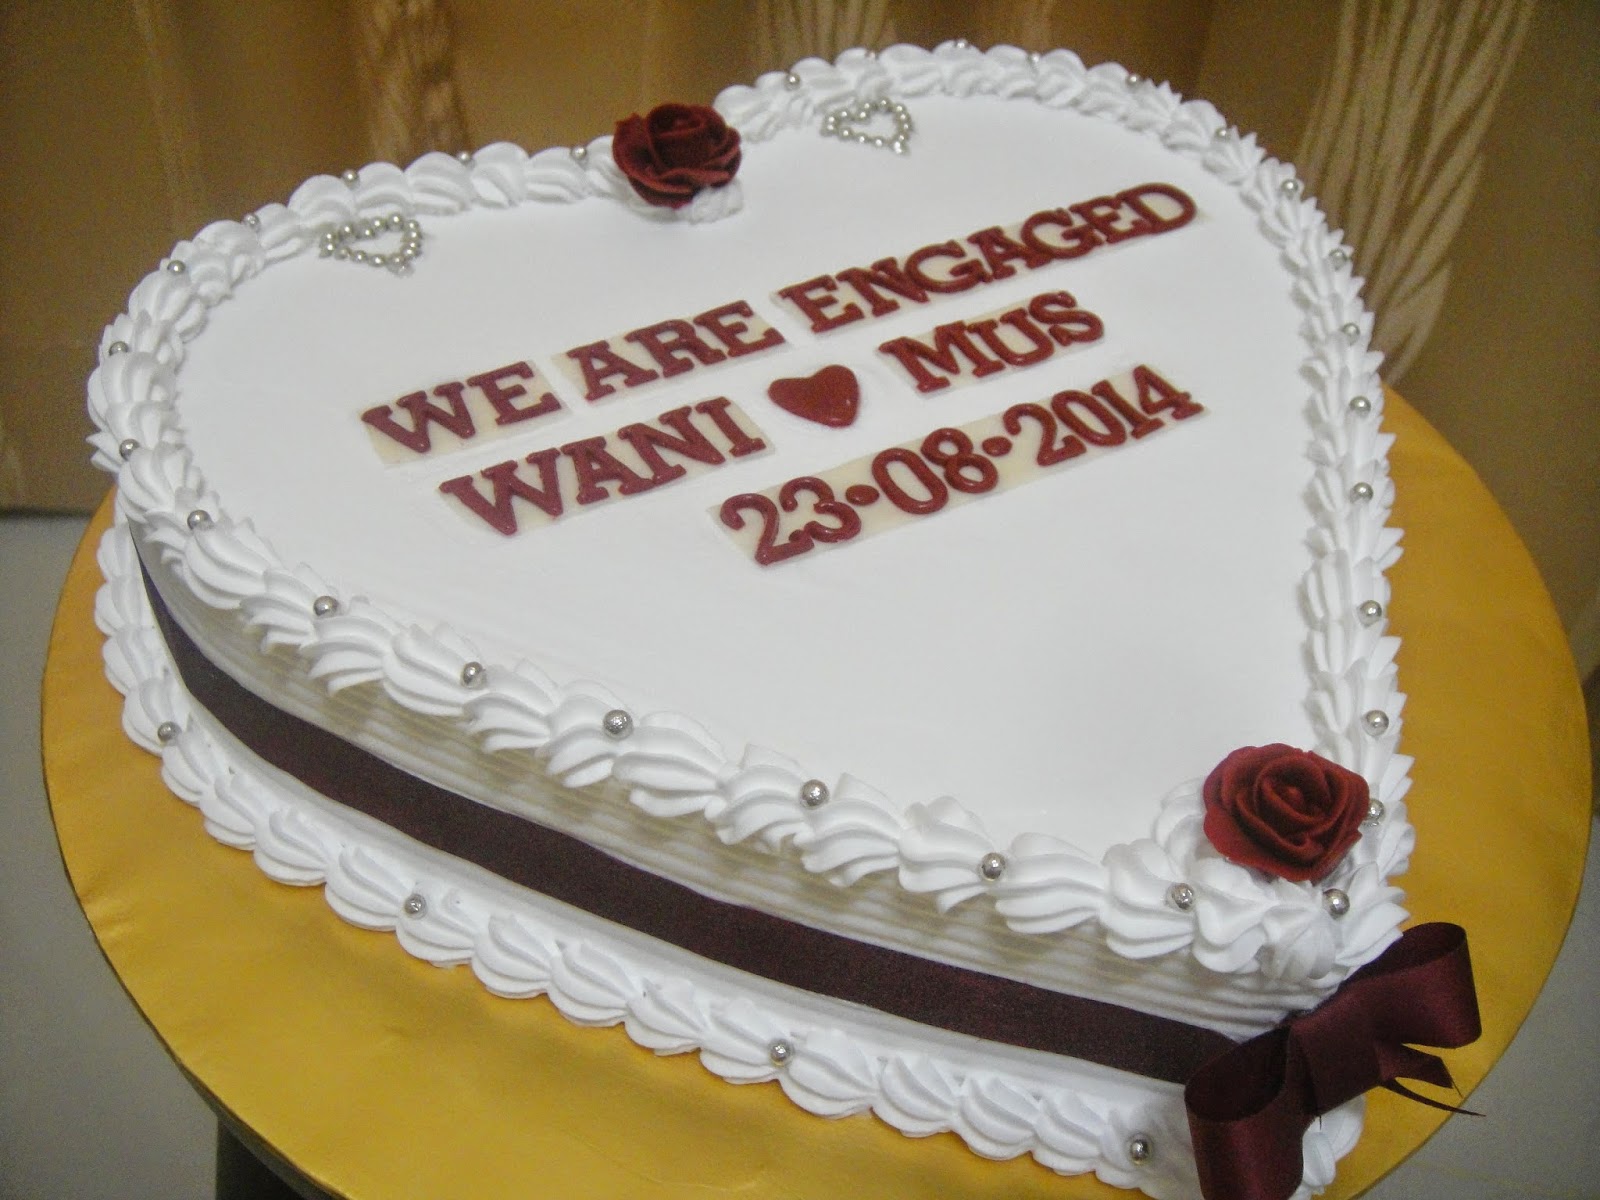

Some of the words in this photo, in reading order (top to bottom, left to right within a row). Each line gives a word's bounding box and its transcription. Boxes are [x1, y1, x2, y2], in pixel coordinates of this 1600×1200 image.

[362, 361, 563, 455] WE
[566, 300, 785, 402] ARE
[779, 182, 1198, 334] ENGAGED
[438, 396, 767, 536] WANI
[879, 291, 1105, 393] MUS
